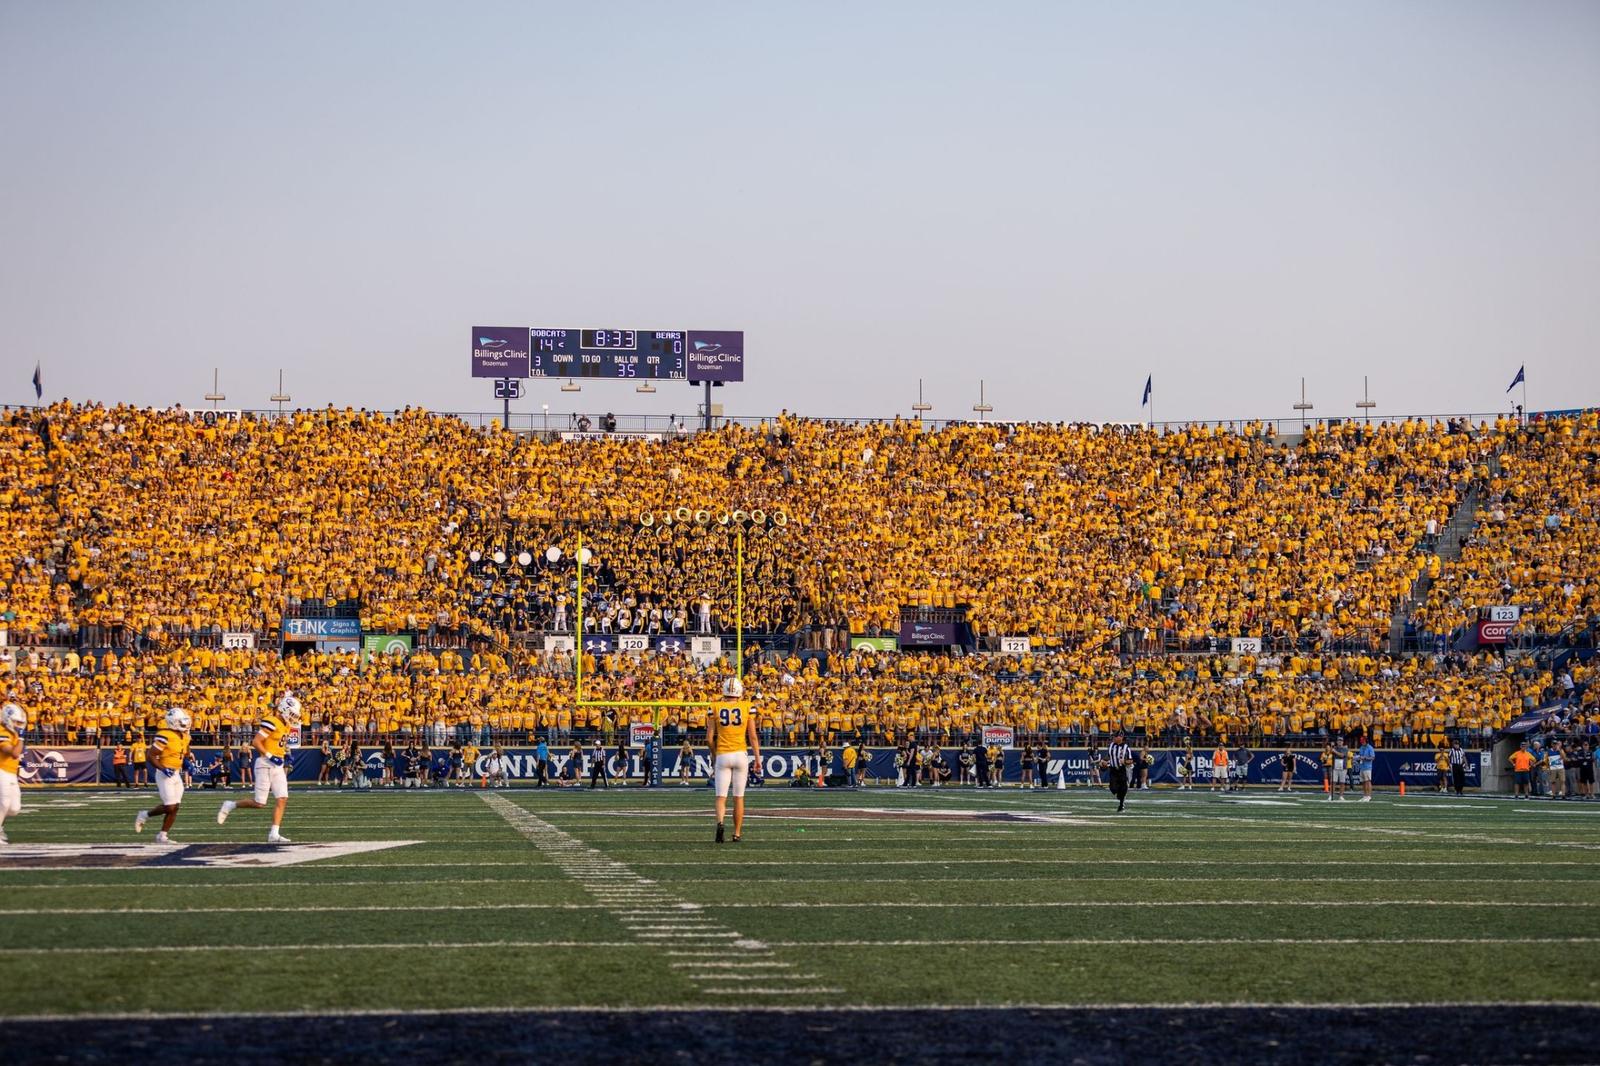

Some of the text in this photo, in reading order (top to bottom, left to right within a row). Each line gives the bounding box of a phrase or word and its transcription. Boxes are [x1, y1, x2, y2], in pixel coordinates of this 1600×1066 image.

[596, 331, 634, 347] 8:33
[540, 339, 553, 351] 14
[674, 341, 681, 354] 0
[474, 349, 528, 360] Billings Clinic
[553, 354, 574, 363] DOWN
[581, 355, 601, 363] TO GO
[614, 355, 628, 363] BALL
[689, 353, 741, 364] Billings Clinic
[535, 356, 541, 366] 3
[647, 356, 660, 364] QTR
[676, 358, 682, 369] 3
[618, 364, 636, 377] 35
[495, 381, 518, 397] 25
[1495, 611, 1514, 620] 123
[911, 632, 930, 640] Billings
[229, 638, 248, 647] 119
[624, 640, 643, 649] 120
[1007, 642, 1025, 651] 121
[1236, 643, 1256, 651] 122
[719, 708, 742, 727] 93
[1260, 755, 1277, 770] ACE
